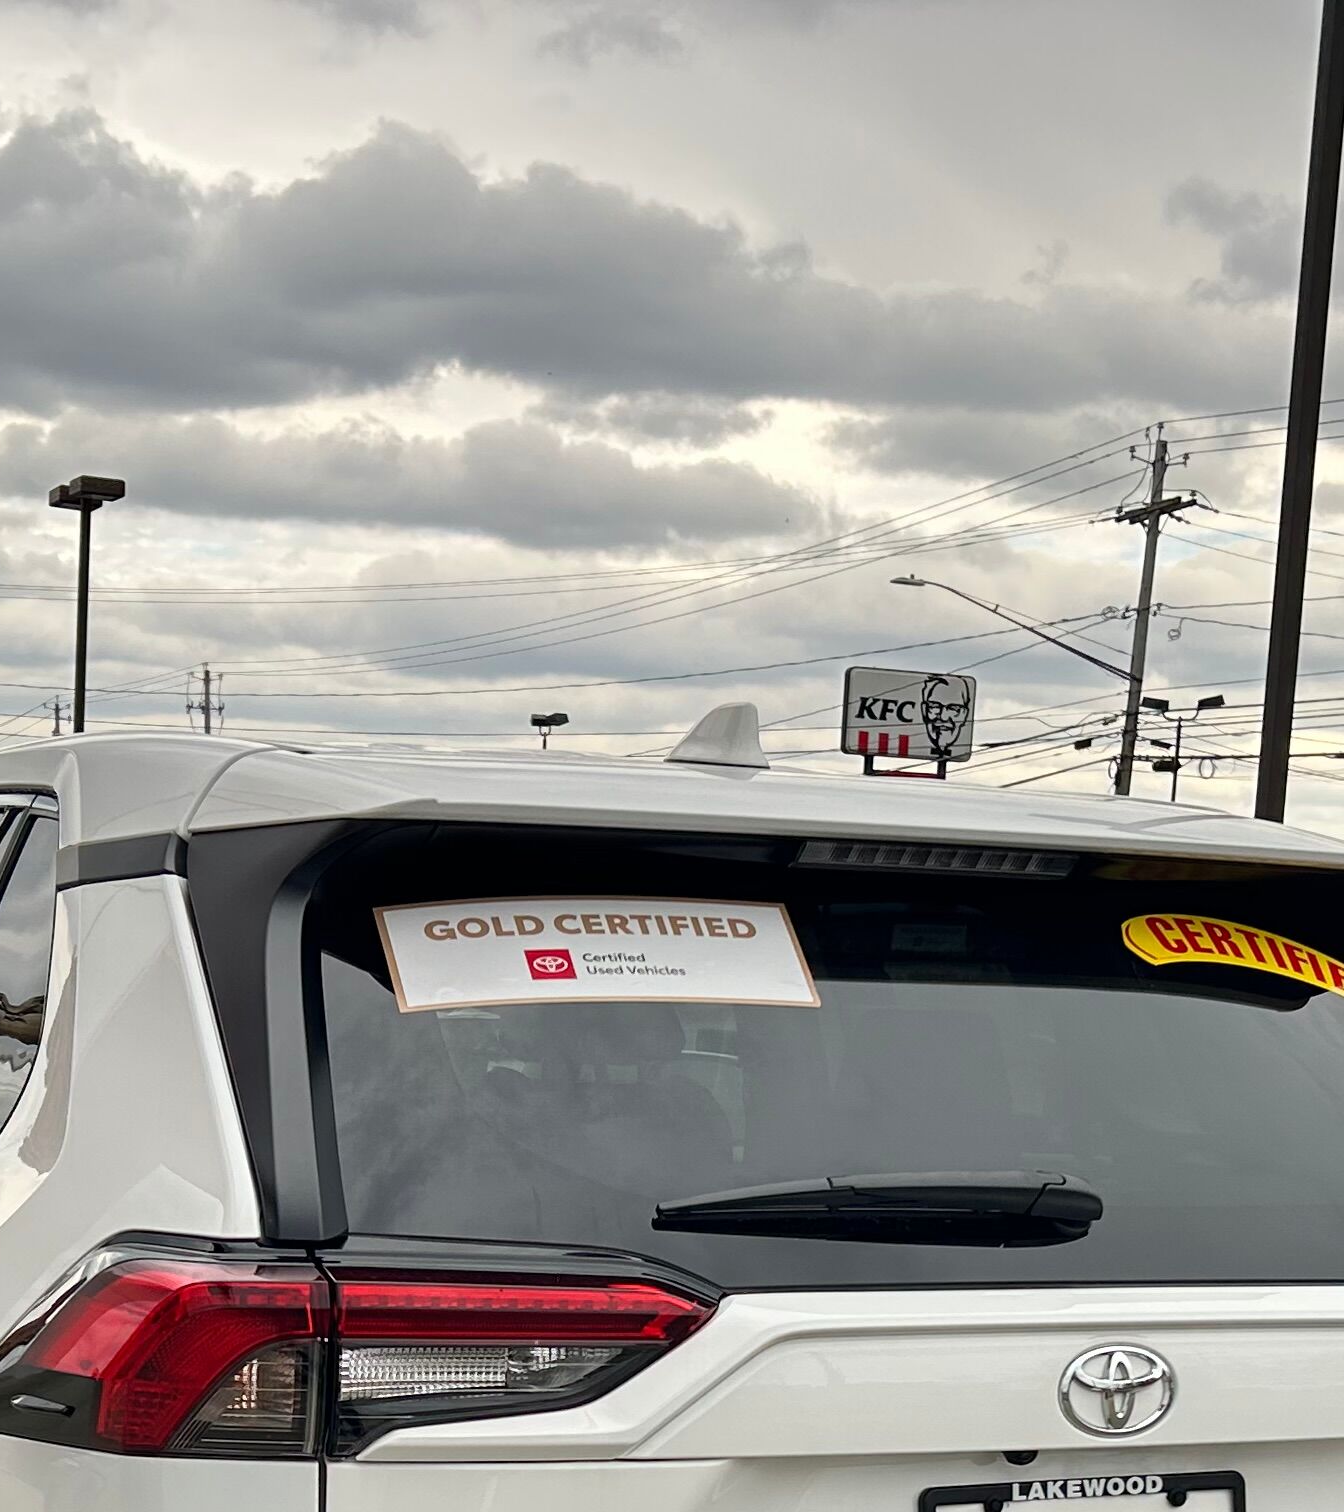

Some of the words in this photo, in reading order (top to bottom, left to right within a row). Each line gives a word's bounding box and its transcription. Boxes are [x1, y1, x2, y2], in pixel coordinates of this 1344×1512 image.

[855, 697, 916, 723] KFC
[424, 915, 545, 941] GOLD
[553, 914, 757, 939] CERTIFIED
[582, 952, 646, 963] Certified
[586, 965, 624, 976] Used
[626, 965, 686, 977] Vehicles
[1012, 1476, 1163, 1501] LAKEWOOD
